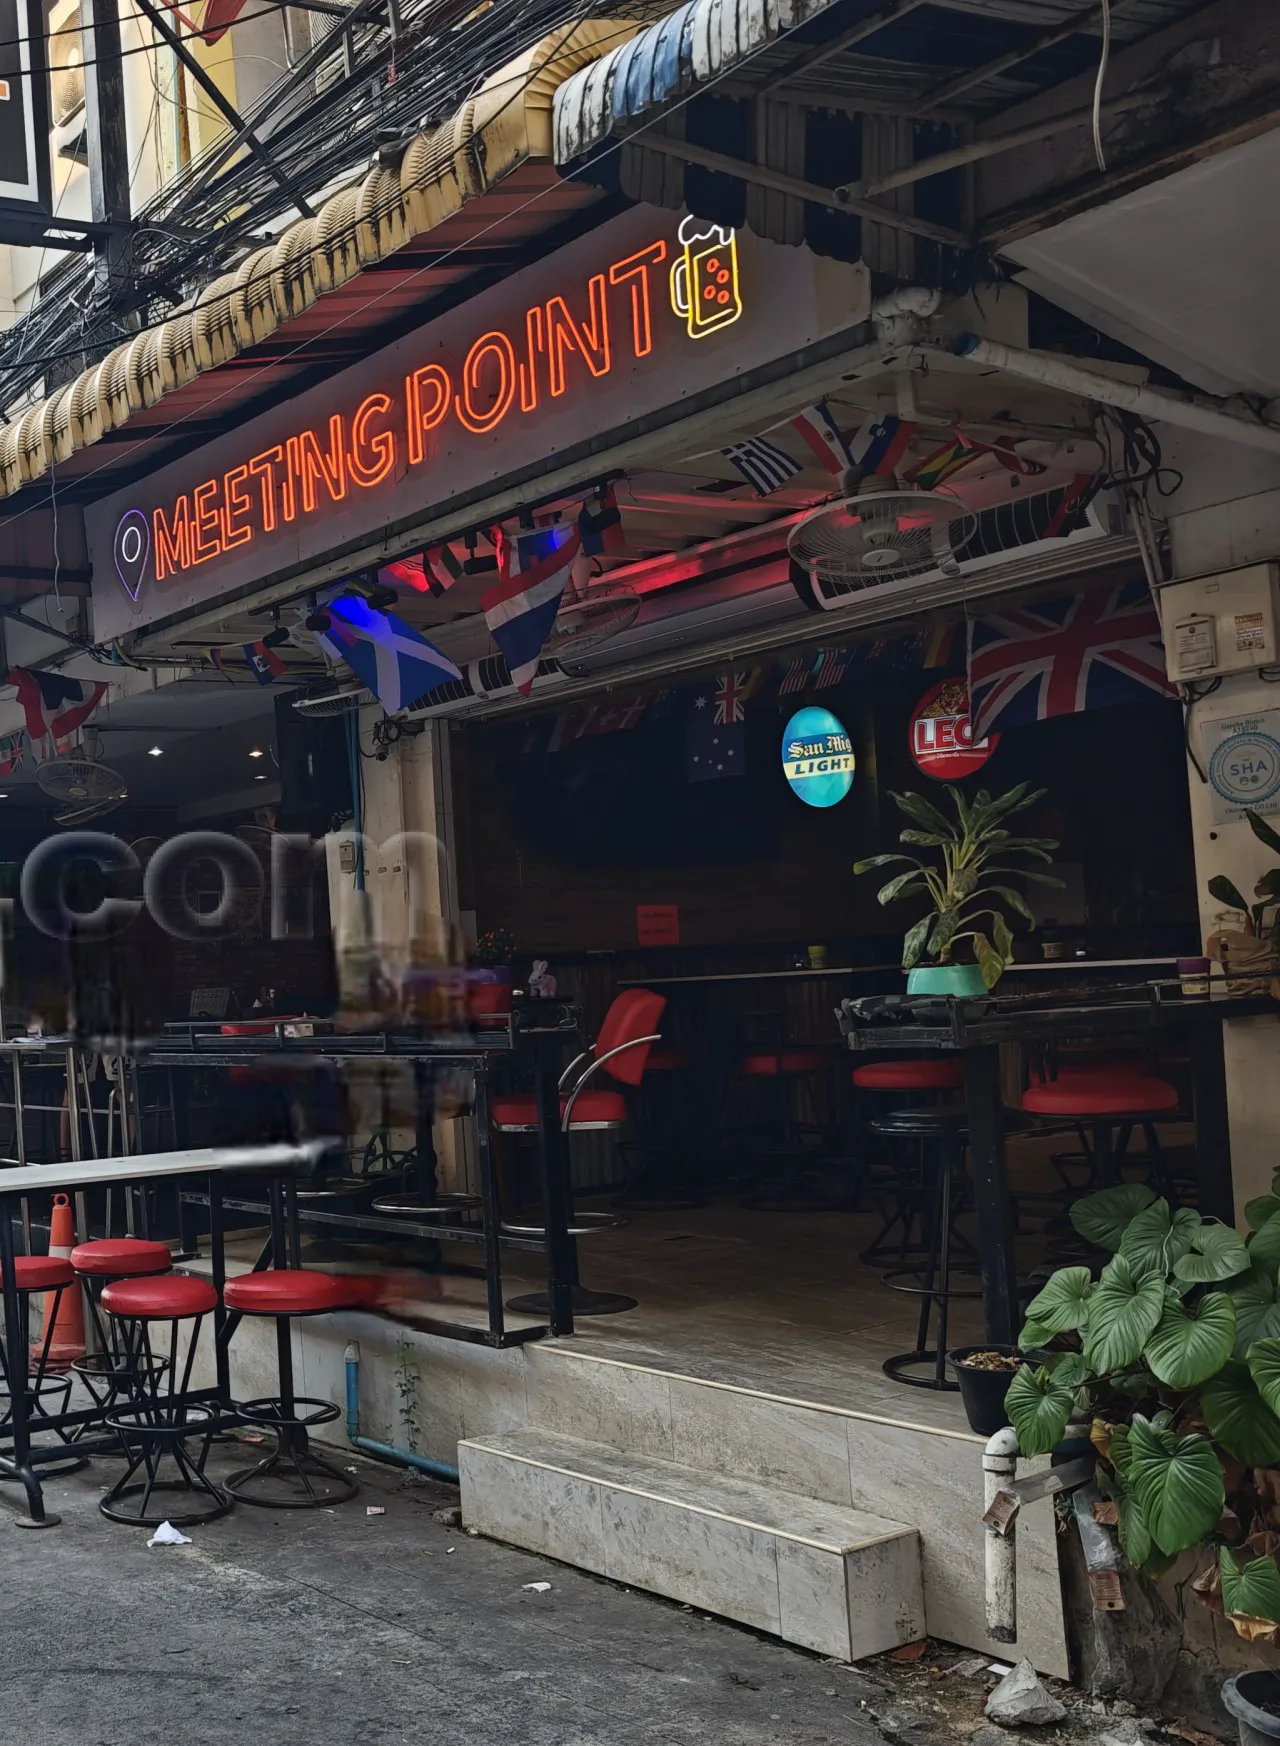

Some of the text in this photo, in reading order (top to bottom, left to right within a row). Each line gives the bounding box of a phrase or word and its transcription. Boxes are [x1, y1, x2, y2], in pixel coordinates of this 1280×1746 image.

[152, 239, 668, 582] MEETING POINT
[787, 738, 824, 759] San
[794, 757, 851, 775] LIGHT
[1230, 759, 1268, 776] SHA
